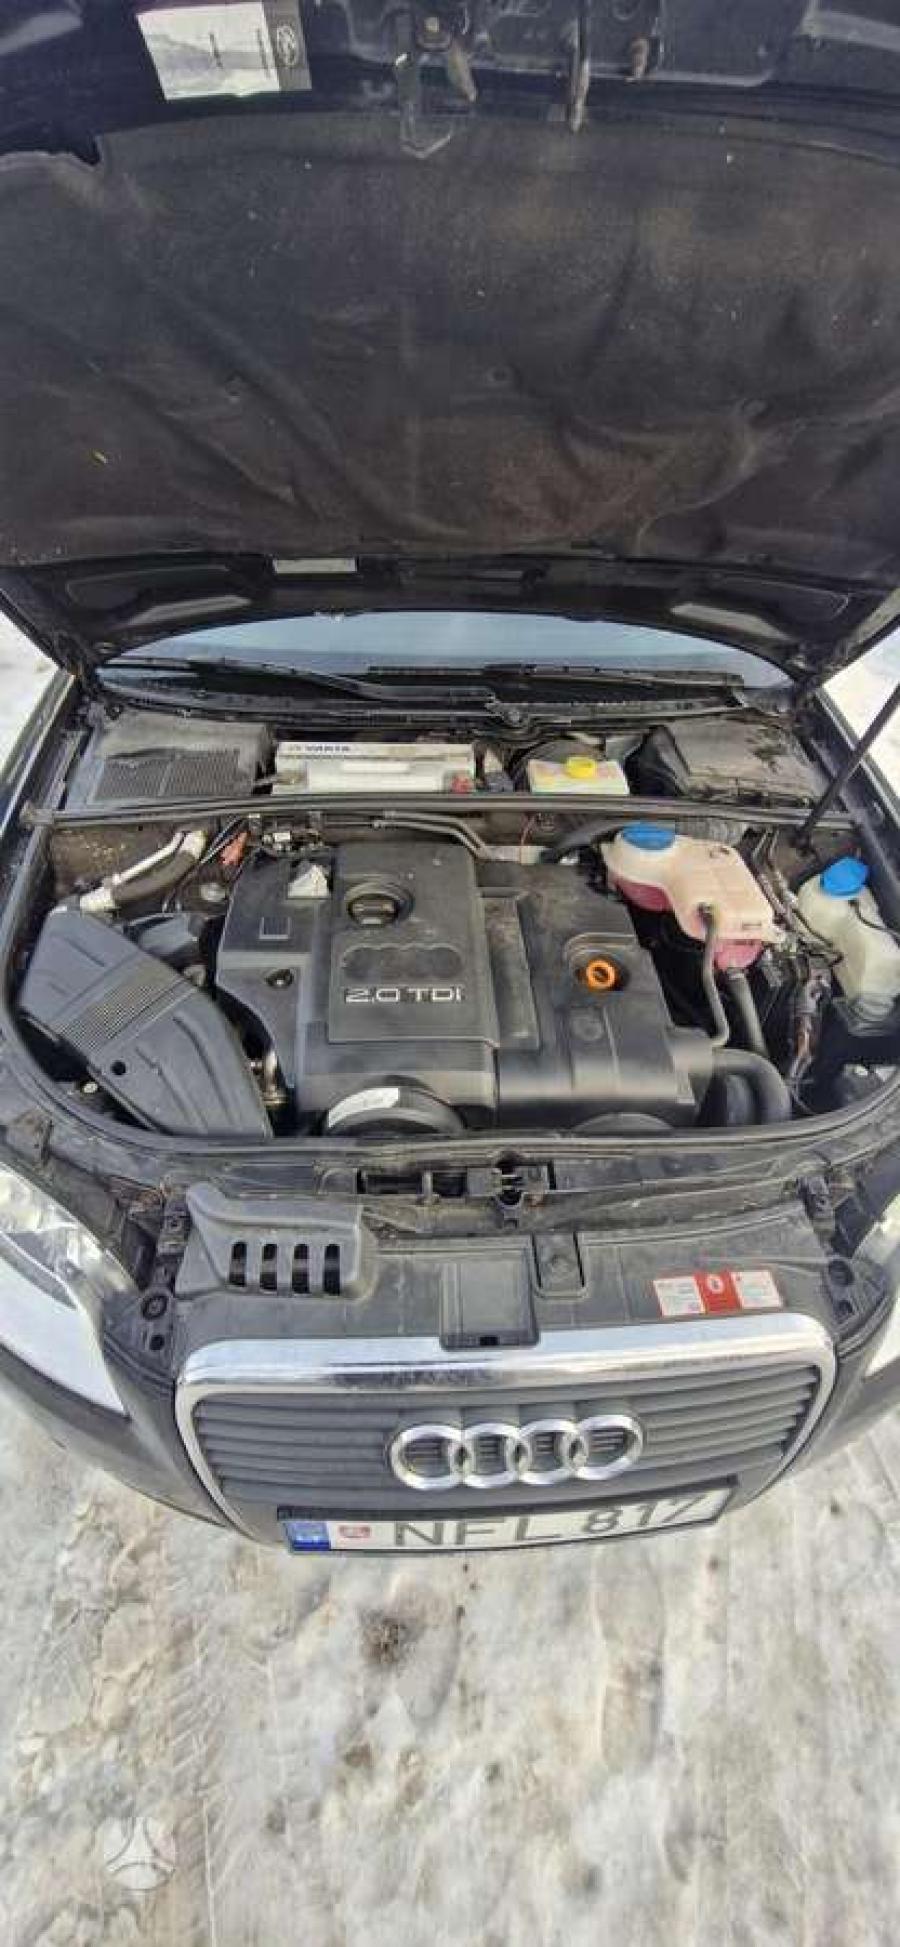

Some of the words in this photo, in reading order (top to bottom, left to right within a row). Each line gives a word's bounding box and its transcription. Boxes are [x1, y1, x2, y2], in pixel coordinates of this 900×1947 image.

[345, 987, 400, 1003] 2.0
[407, 986, 463, 1003] TDI
[395, 1515, 562, 1547] NFL
[583, 1492, 707, 1532] 817
